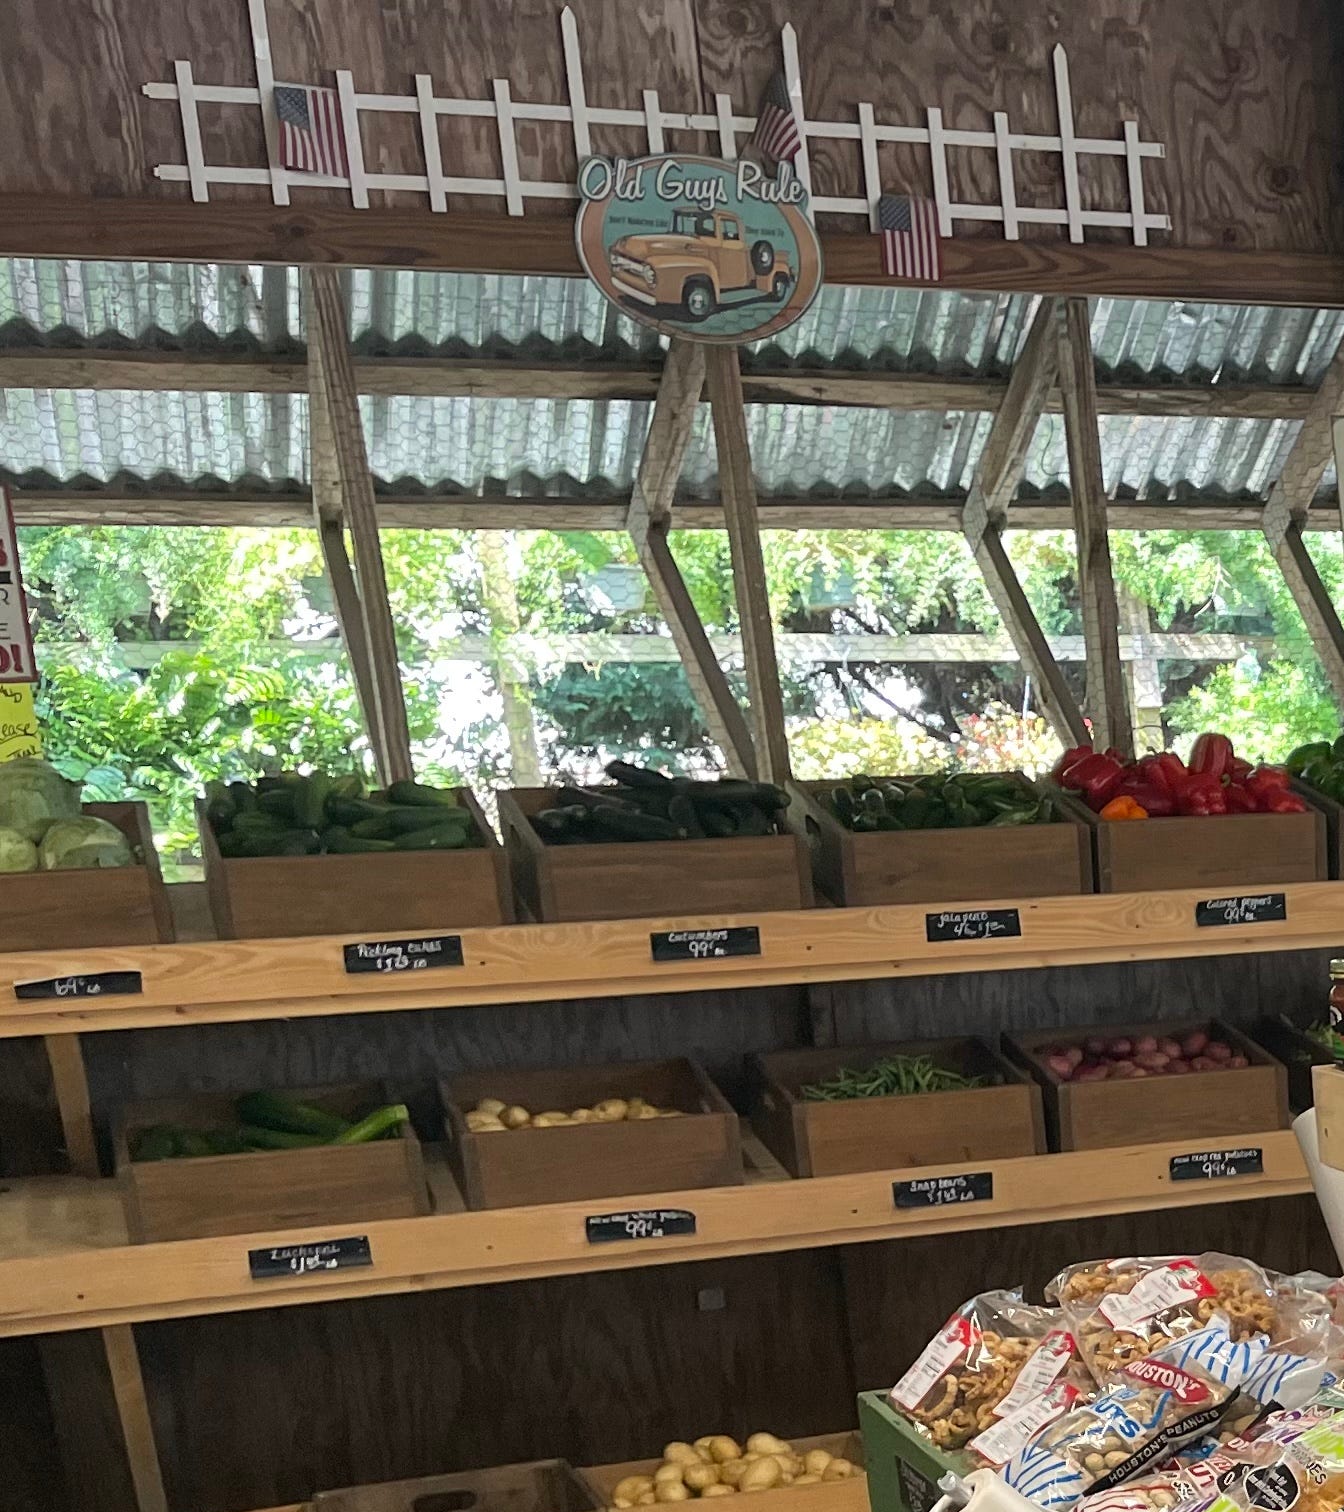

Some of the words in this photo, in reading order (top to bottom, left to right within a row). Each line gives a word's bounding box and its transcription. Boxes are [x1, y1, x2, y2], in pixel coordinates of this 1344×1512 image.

[581, 158, 645, 200] Old
[656, 158, 728, 211] Guys
[737, 160, 805, 202] Rule
[1108, 1434, 1168, 1483] HOUSTON'S
[1166, 1409, 1219, 1437] PEANUTS
